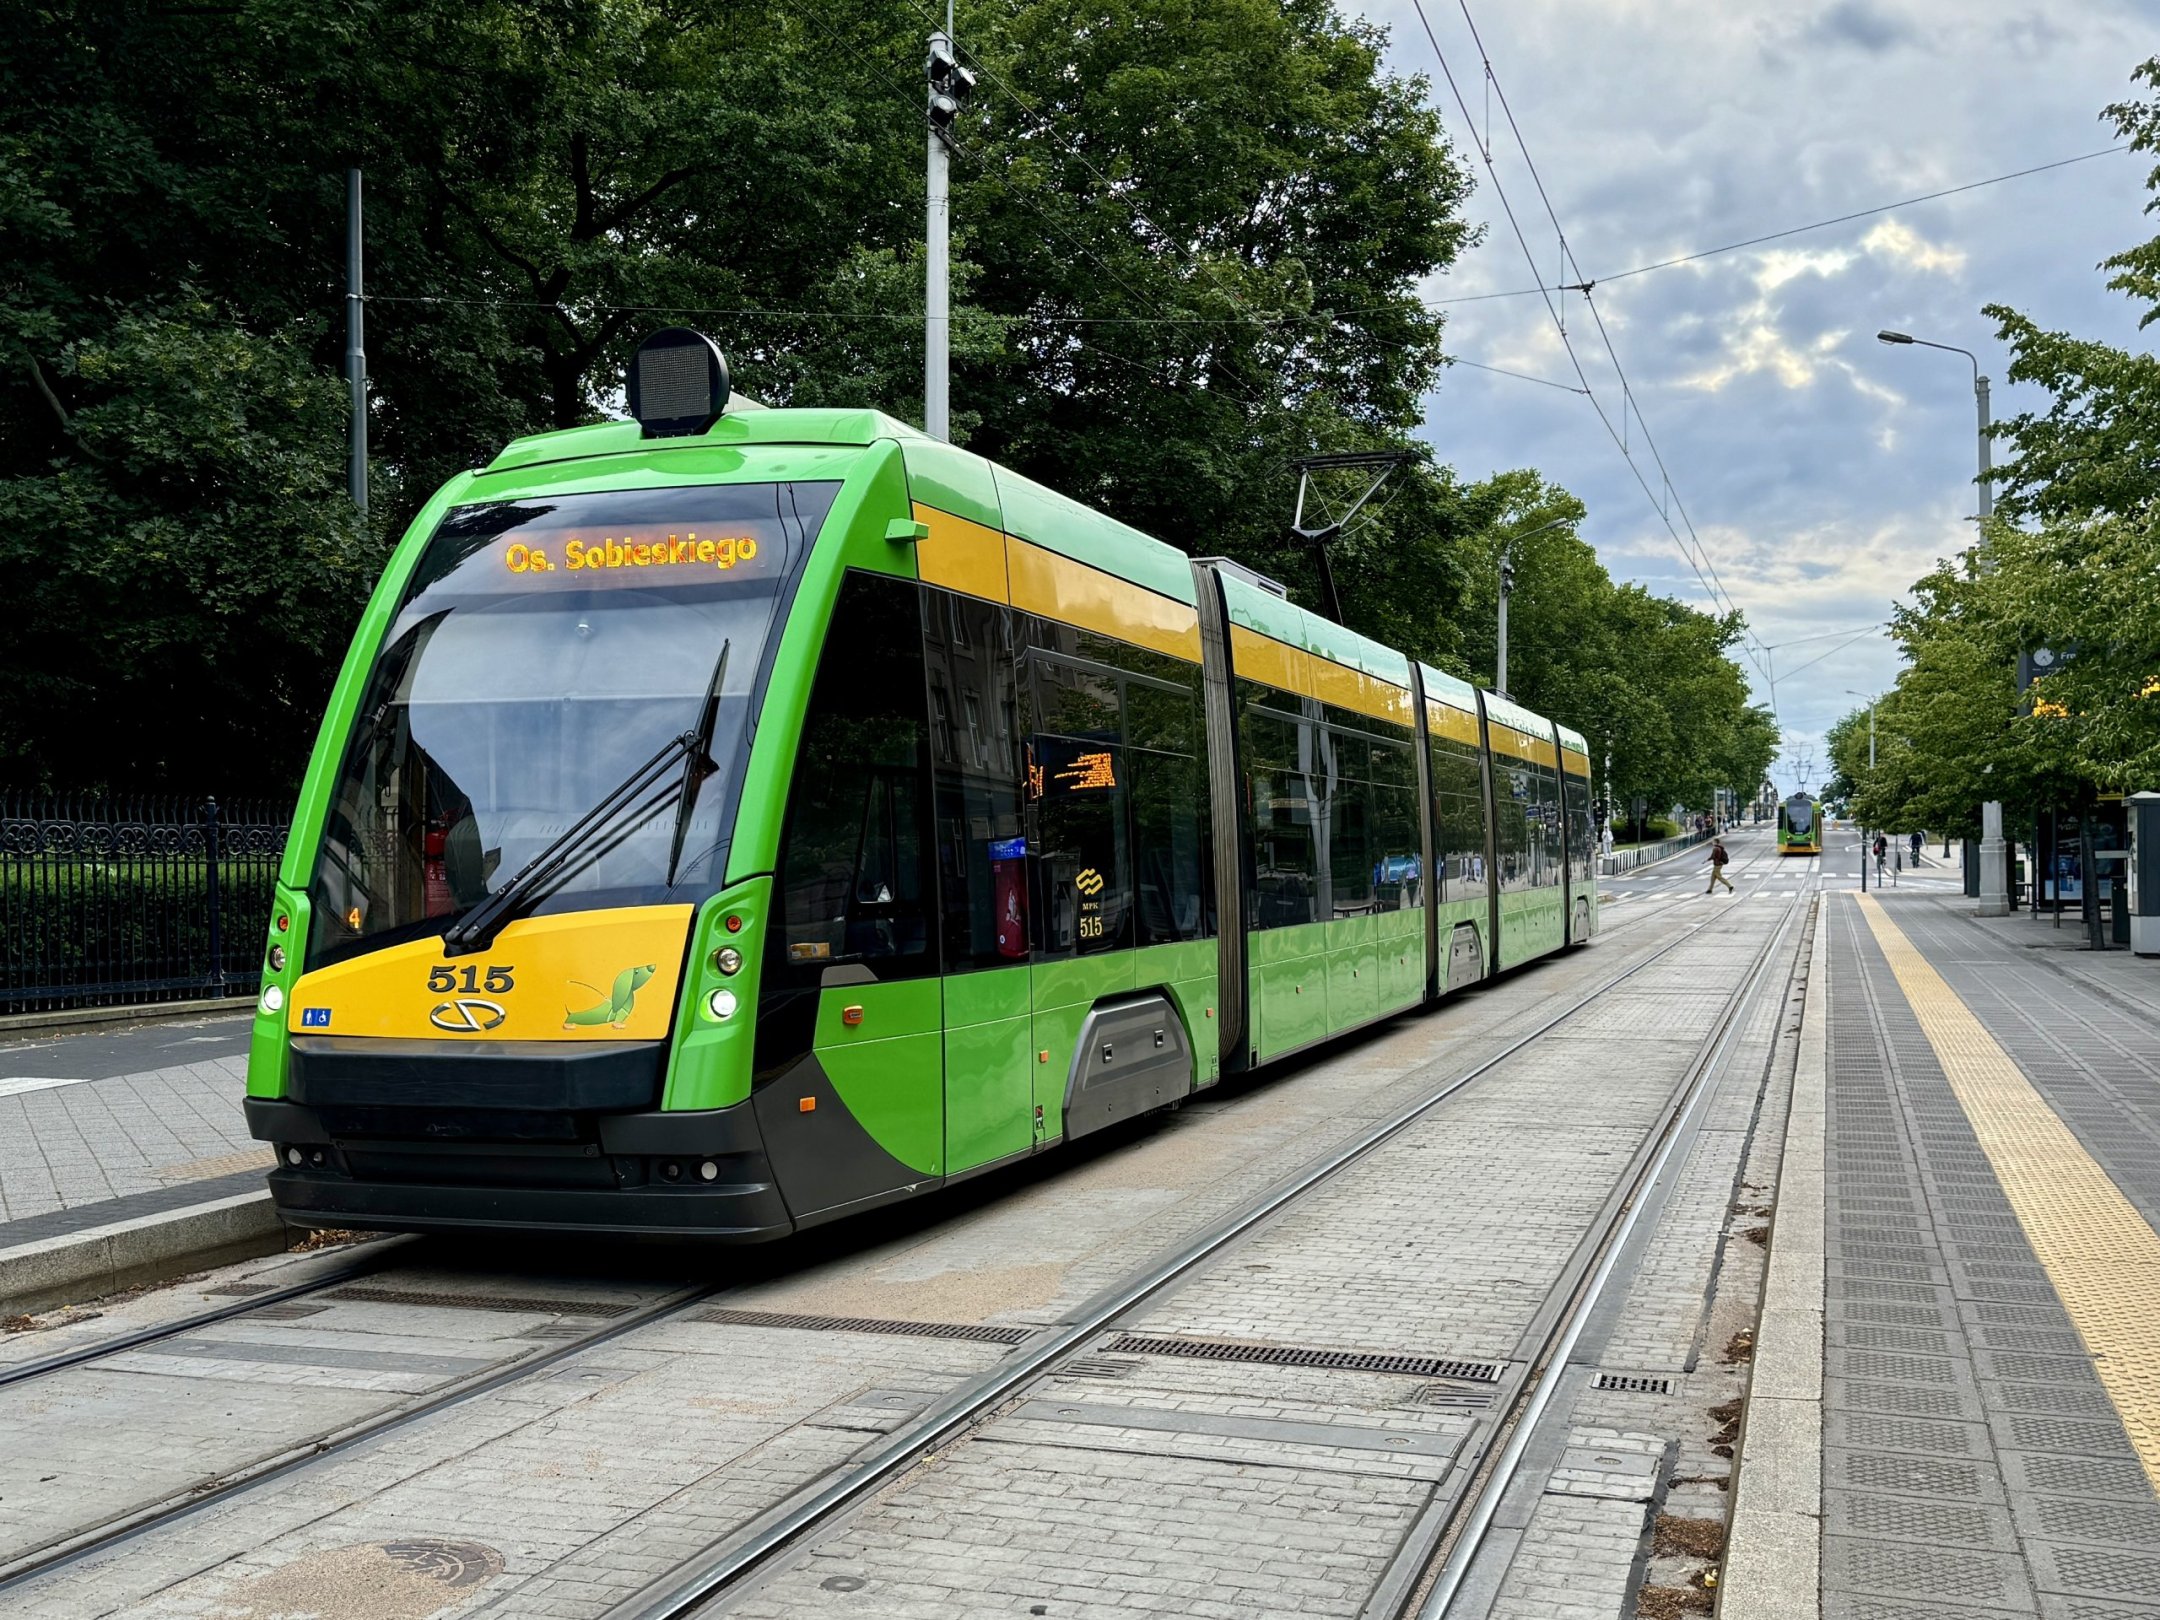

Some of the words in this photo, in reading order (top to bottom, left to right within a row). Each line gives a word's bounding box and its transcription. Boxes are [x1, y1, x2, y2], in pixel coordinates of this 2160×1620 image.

[506, 543, 555, 573] Os.
[565, 533, 757, 569] Sobieskiego
[1082, 902, 1099, 911] MPK
[348, 907, 361, 930] 4
[1080, 916, 1103, 938] 515
[427, 964, 515, 994] 515
